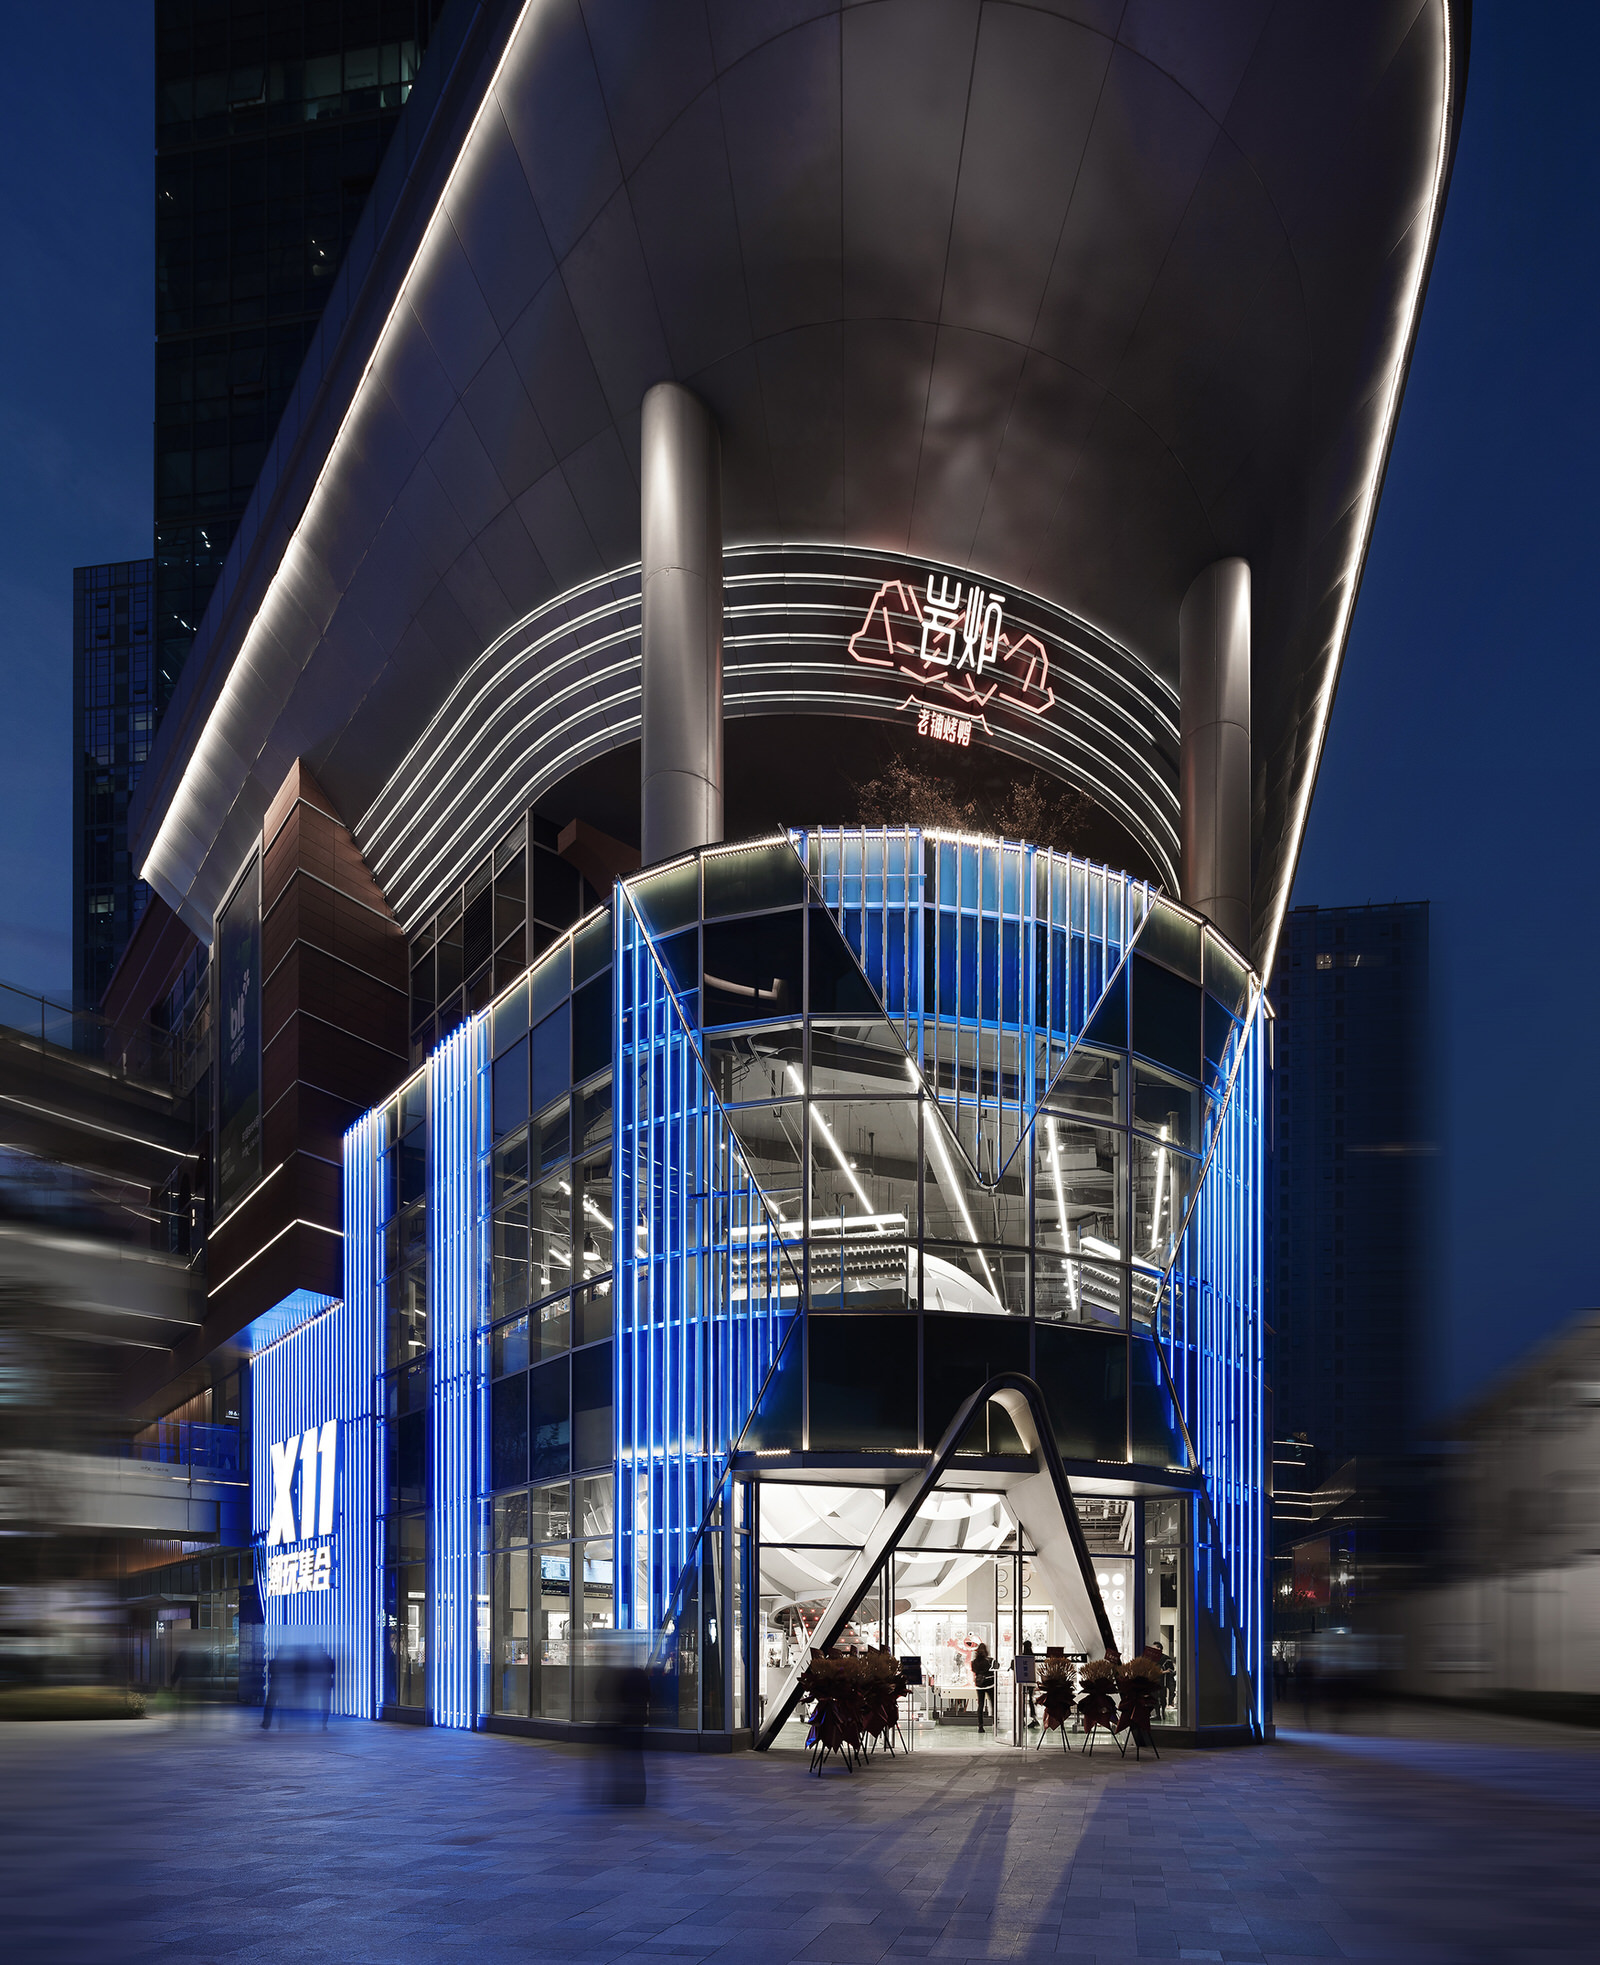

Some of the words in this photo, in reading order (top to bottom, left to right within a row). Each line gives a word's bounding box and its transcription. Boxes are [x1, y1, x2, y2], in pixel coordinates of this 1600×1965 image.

[920, 574, 1006, 675] 岩炉
[917, 708, 972, 747] 老铺烤鸭
[267, 1418, 337, 1547] X11
[267, 1545, 331, 1597] 潮玩集合
